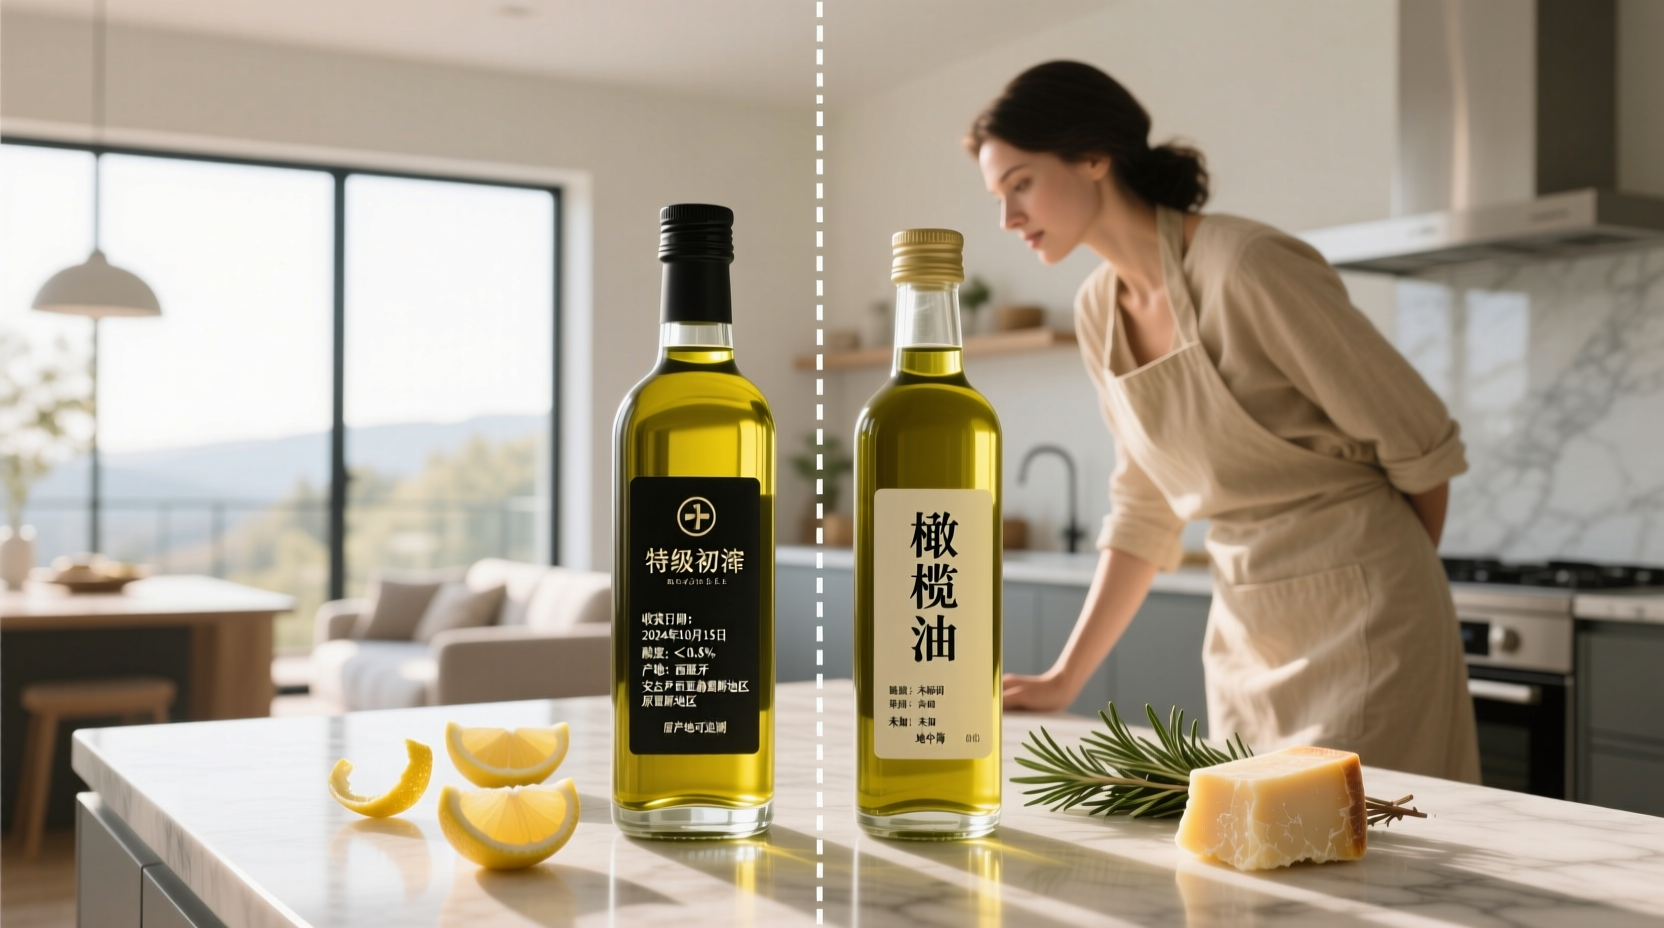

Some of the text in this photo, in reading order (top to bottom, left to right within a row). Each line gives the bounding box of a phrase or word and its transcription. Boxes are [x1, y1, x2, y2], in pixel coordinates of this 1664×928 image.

[909, 511, 959, 663] 橄榄油
[641, 628, 726, 643] 2024年10月15日
